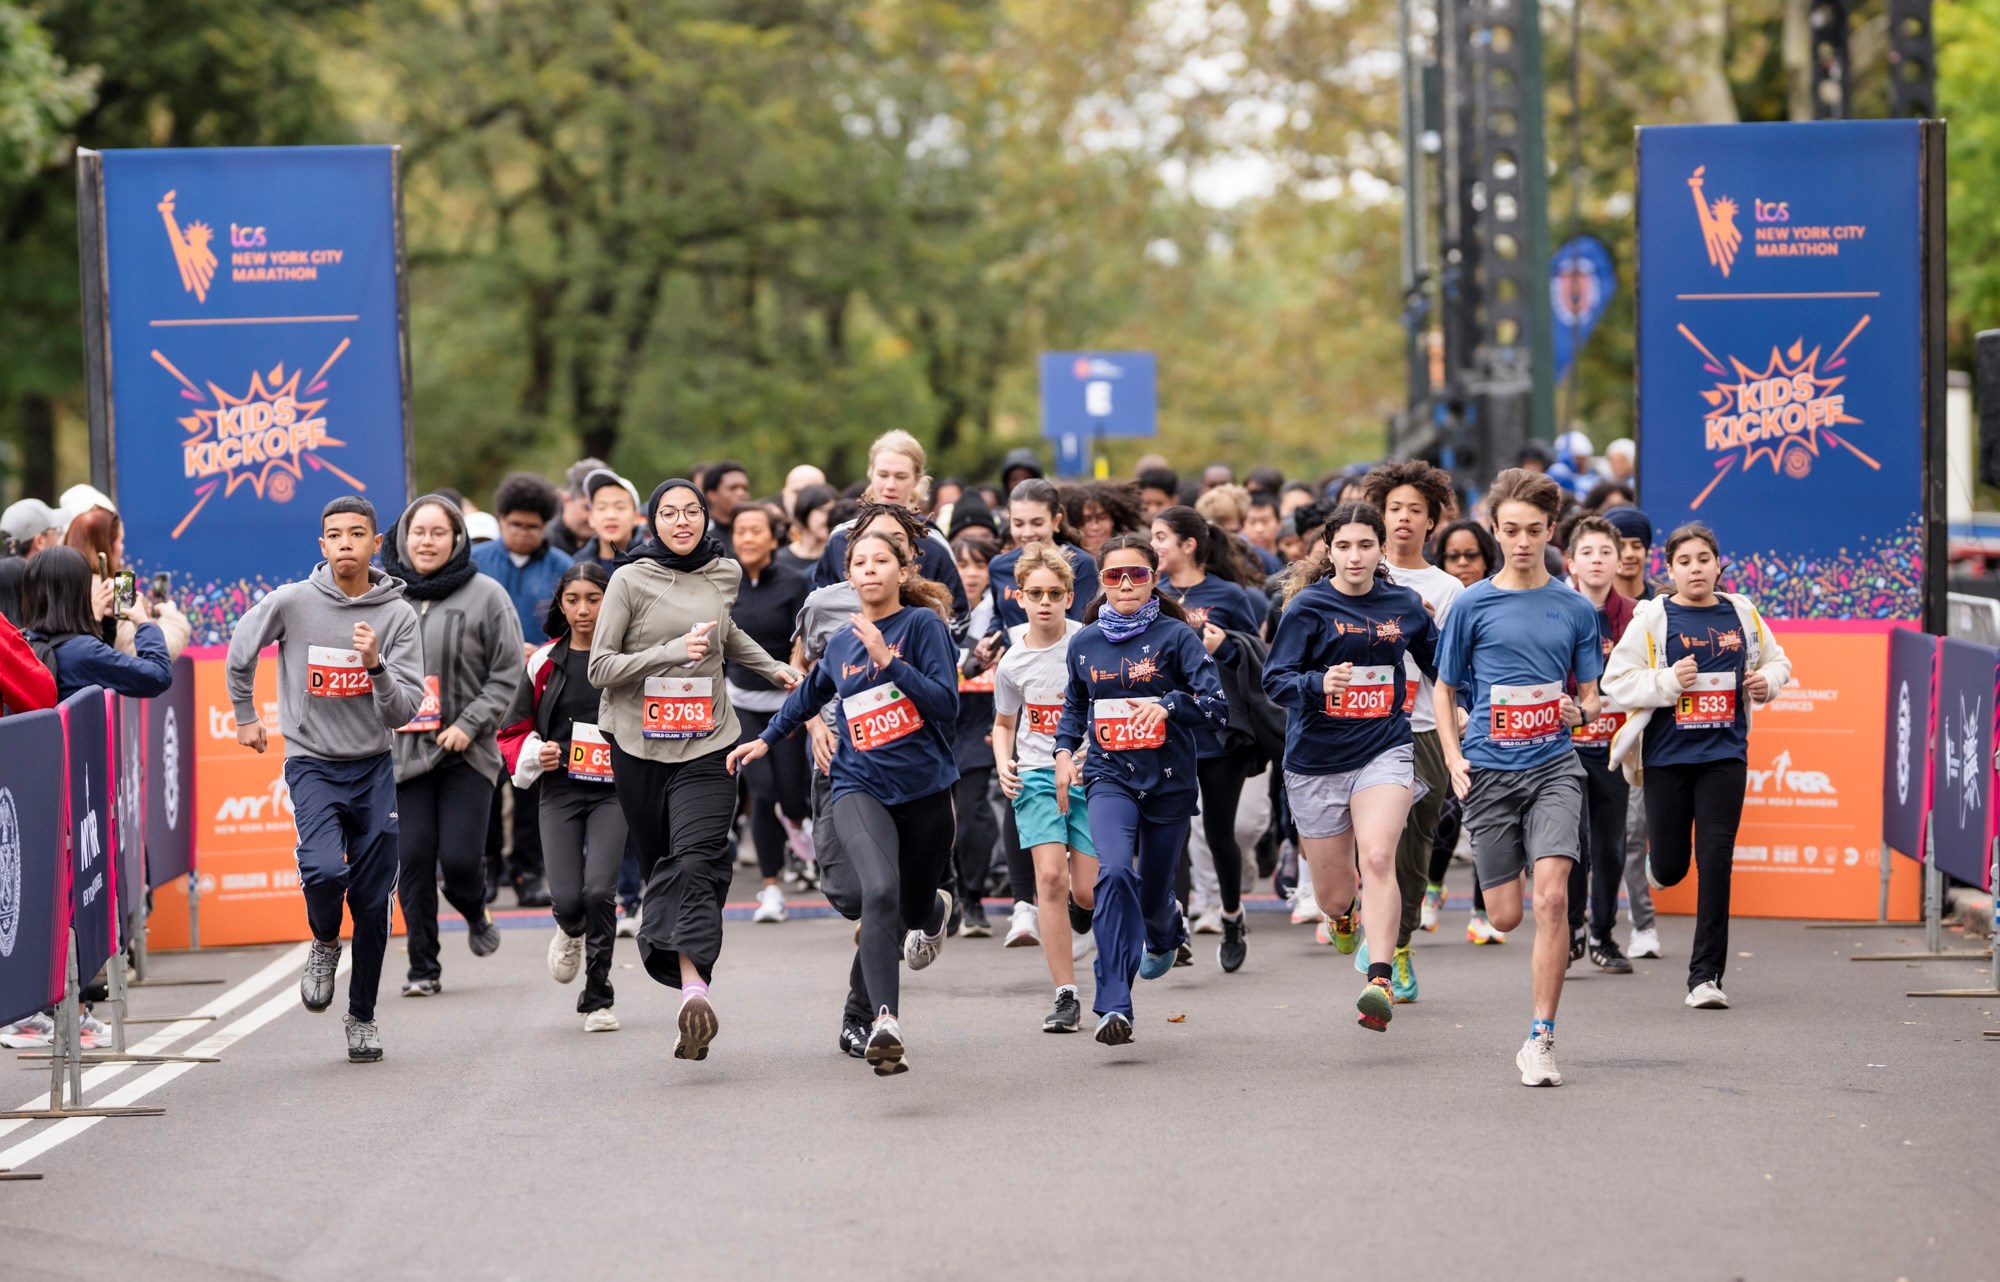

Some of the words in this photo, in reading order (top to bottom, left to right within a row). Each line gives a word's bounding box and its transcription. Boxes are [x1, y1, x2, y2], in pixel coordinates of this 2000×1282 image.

[1755, 197, 1790, 222] tcs
[230, 222, 267, 248] tcs
[1755, 226, 1790, 241] NEW
[1792, 225, 1831, 241] YORK
[1833, 225, 1866, 240] CITY
[231, 251, 267, 266] NEW
[269, 250, 309, 265] YORK
[311, 249, 344, 265] CITY
[1755, 242, 1839, 257] MARATHON
[232, 267, 318, 282] MARATHON
[1738, 372, 1815, 415] KIDS
[217, 396, 297, 440] KIDS
[1705, 394, 1845, 450] KICKOFF
[184, 417, 328, 478] KICKOFF
[312, 671, 323, 688] D
[329, 671, 369, 690] 2122
[1331, 694, 1341, 707] E
[1347, 690, 1385, 709] 2061
[1681, 698, 1690, 712] F
[1698, 696, 1728, 713] 533
[648, 703, 659, 720] C
[663, 703, 705, 721] 3763
[1030, 709, 1040, 725] B
[1495, 712, 1506, 729] E
[1511, 706, 1555, 729] 3000
[853, 723, 863, 741] E
[865, 706, 910, 738] 2091
[1099, 726, 1111, 742] C
[574, 746, 584, 762] D
[592, 748, 611, 767] 63
